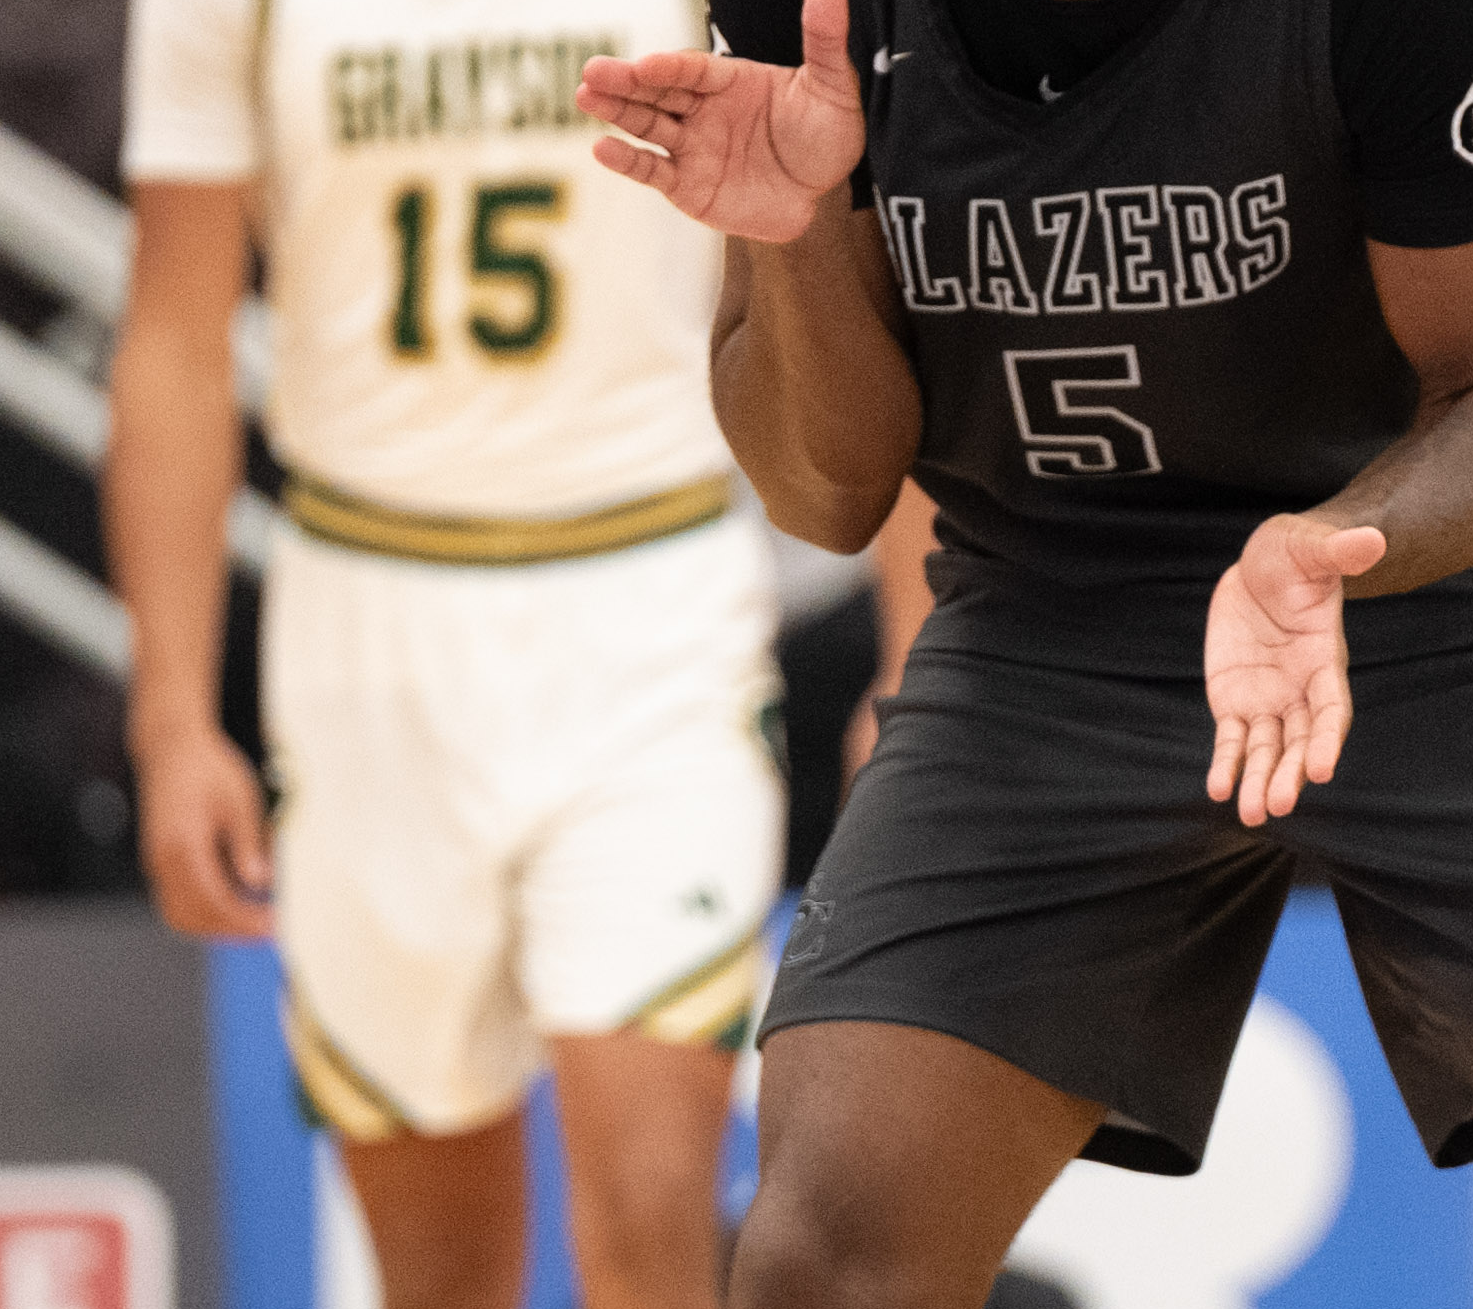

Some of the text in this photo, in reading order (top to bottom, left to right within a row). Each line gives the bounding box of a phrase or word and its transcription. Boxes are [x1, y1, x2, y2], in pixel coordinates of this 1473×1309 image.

[384, 177, 570, 368] 15
[873, 173, 1292, 315] LAZERS
[1002, 343, 1163, 478] 5
